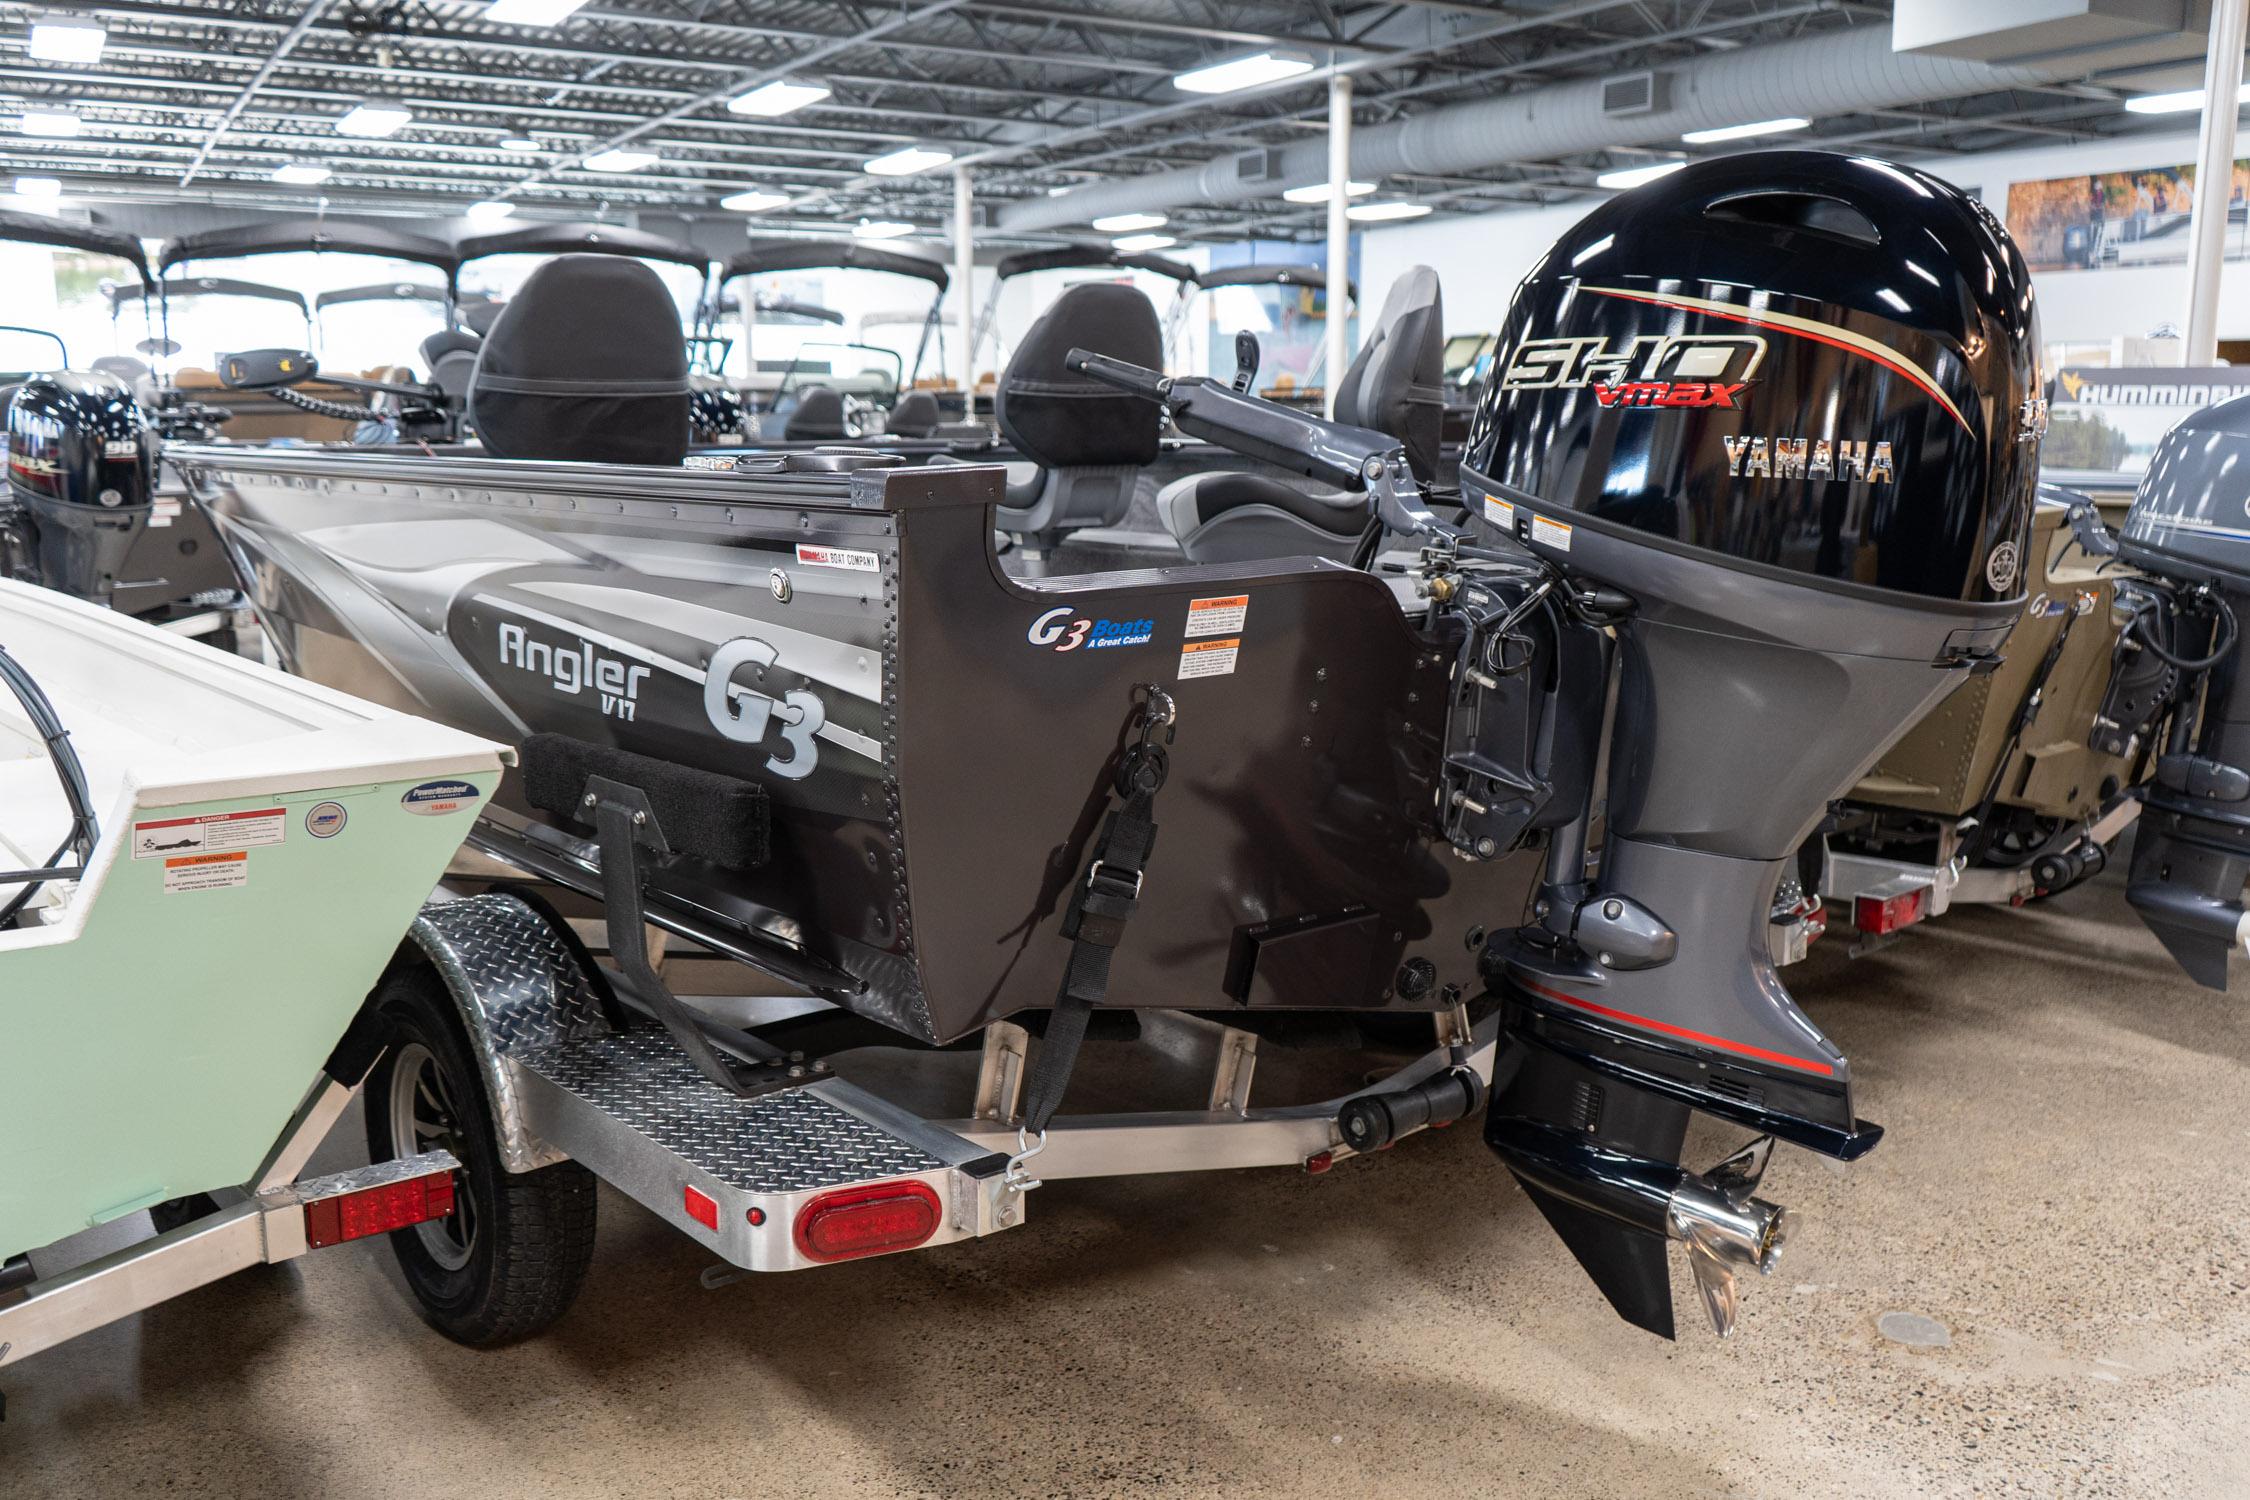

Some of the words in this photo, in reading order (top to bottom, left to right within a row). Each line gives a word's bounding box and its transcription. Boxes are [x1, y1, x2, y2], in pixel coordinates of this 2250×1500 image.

[104, 440, 138, 455] 90
[1723, 434, 1894, 484] YAMAHA
[830, 552, 845, 564] BOAT
[847, 555, 874, 567] COMPANY
[1211, 599, 1238, 607] WARNING
[1028, 606, 1092, 652] G3
[1091, 619, 1155, 638] Boats
[1087, 640, 1095, 648] A
[1097, 637, 1122, 648] Great
[1122, 634, 1152, 645] Catch!
[1202, 641, 1228, 649] WARNING
[499, 621, 651, 700] Angler
[601, 693, 636, 722] V17
[703, 635, 826, 781] G3
[201, 815, 230, 823] DANGER
